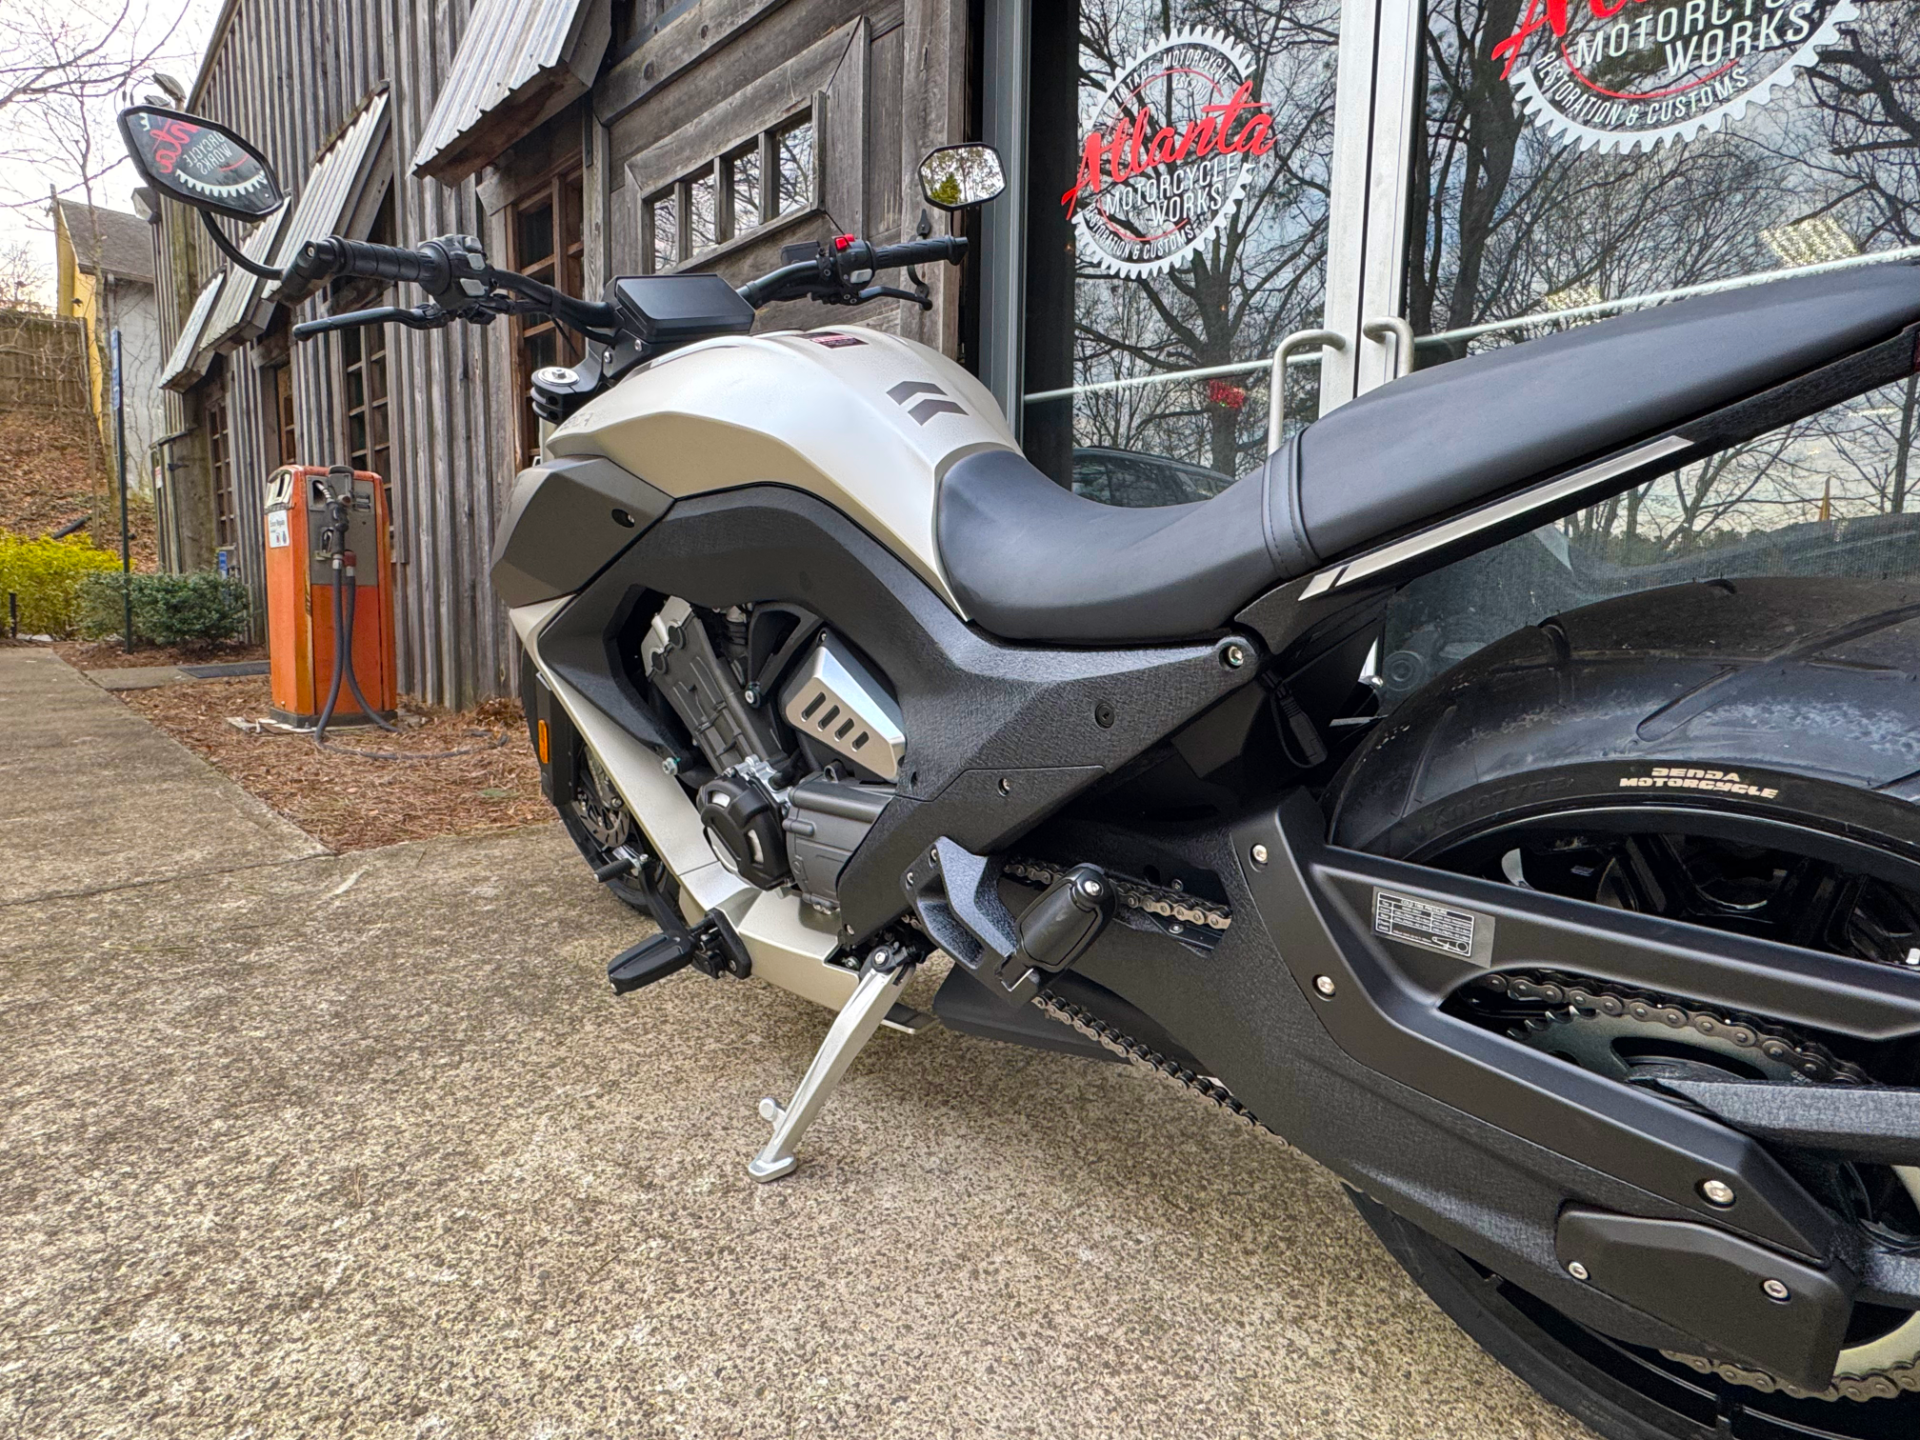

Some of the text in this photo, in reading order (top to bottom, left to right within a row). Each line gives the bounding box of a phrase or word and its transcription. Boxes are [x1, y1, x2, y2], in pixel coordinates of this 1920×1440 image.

[1575, 0, 1784, 68] MOTORC
[1665, 3, 1811, 77] WORKS
[1111, 49, 1234, 105] VINTAGE MOTORCYCLE
[1536, 51, 1749, 126] RESTORATION & CUSTOMS
[1061, 81, 1278, 220] Atlanta
[1106, 152, 1238, 216] MOTORCYCLE
[1151, 184, 1223, 227] WORKS
[1085, 202, 1195, 260] RESTORATION & CUSTOMS
[1619, 777, 1779, 799] MOTORCYCLE
